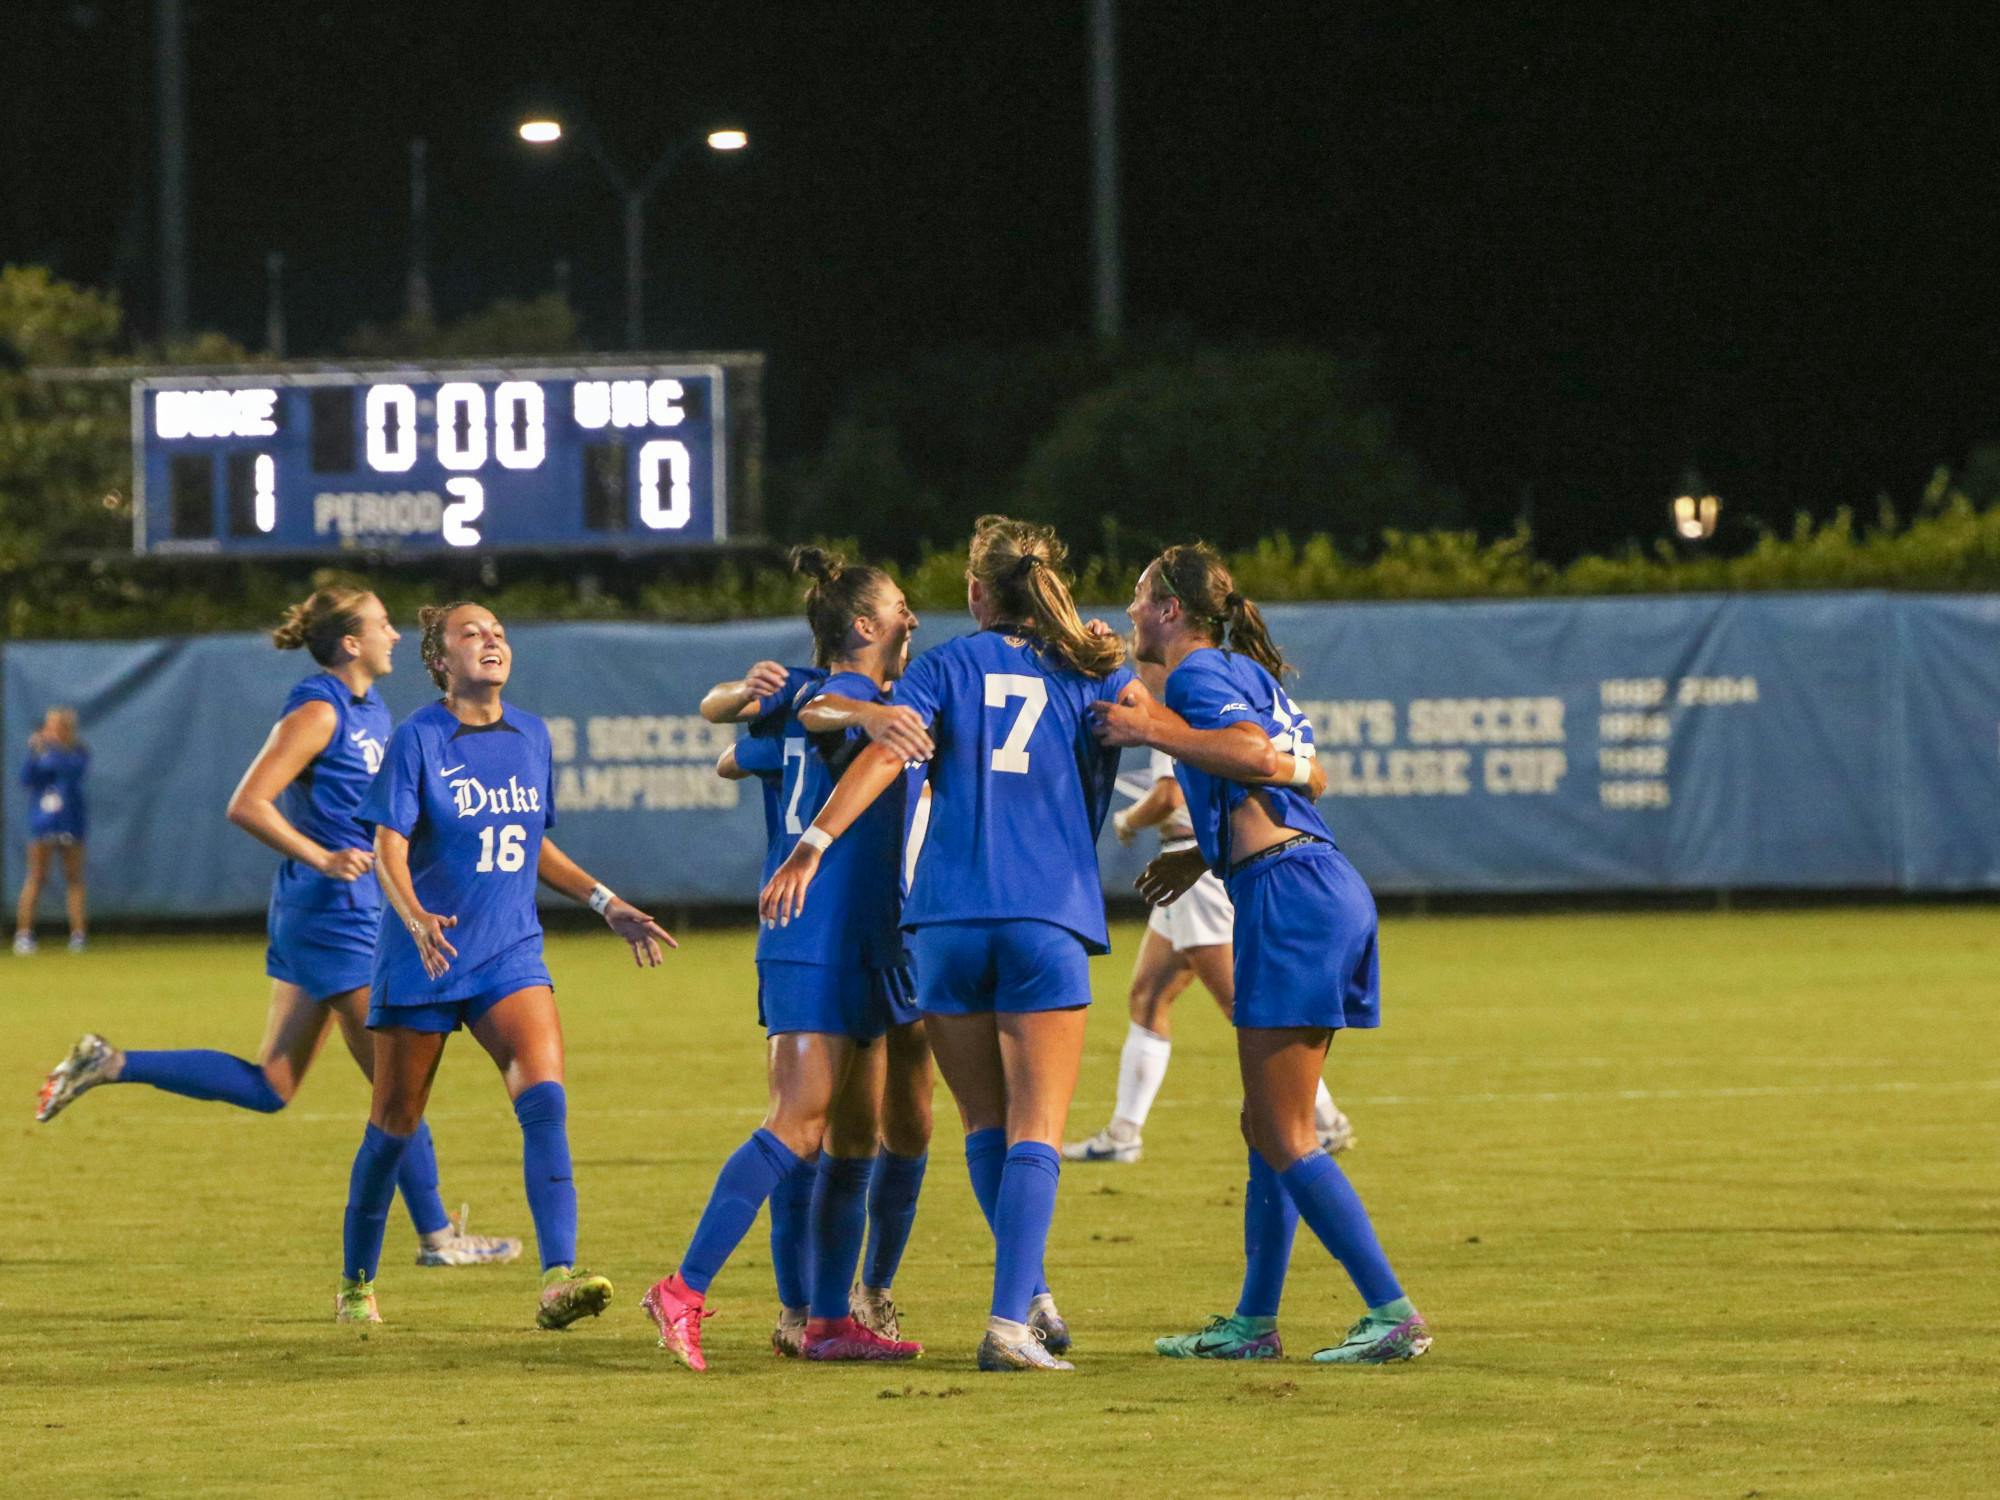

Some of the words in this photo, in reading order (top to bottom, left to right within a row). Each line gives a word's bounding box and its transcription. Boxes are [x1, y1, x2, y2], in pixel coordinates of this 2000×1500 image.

[574, 379, 685, 428] UNC
[255, 454, 275, 532] 1
[640, 440, 690, 529] 0
[314, 491, 442, 537] PERIOD
[443, 477, 484, 546] 2
[984, 673, 1049, 775] 7
[1219, 702, 1248, 716] ACC
[1408, 697, 1565, 743] SOCCER
[587, 714, 738, 760] SOCCER
[556, 765, 740, 811] AMPIONS
[1484, 748, 1567, 795] CUP
[449, 775, 541, 819] Duke
[476, 824, 527, 873] 16
